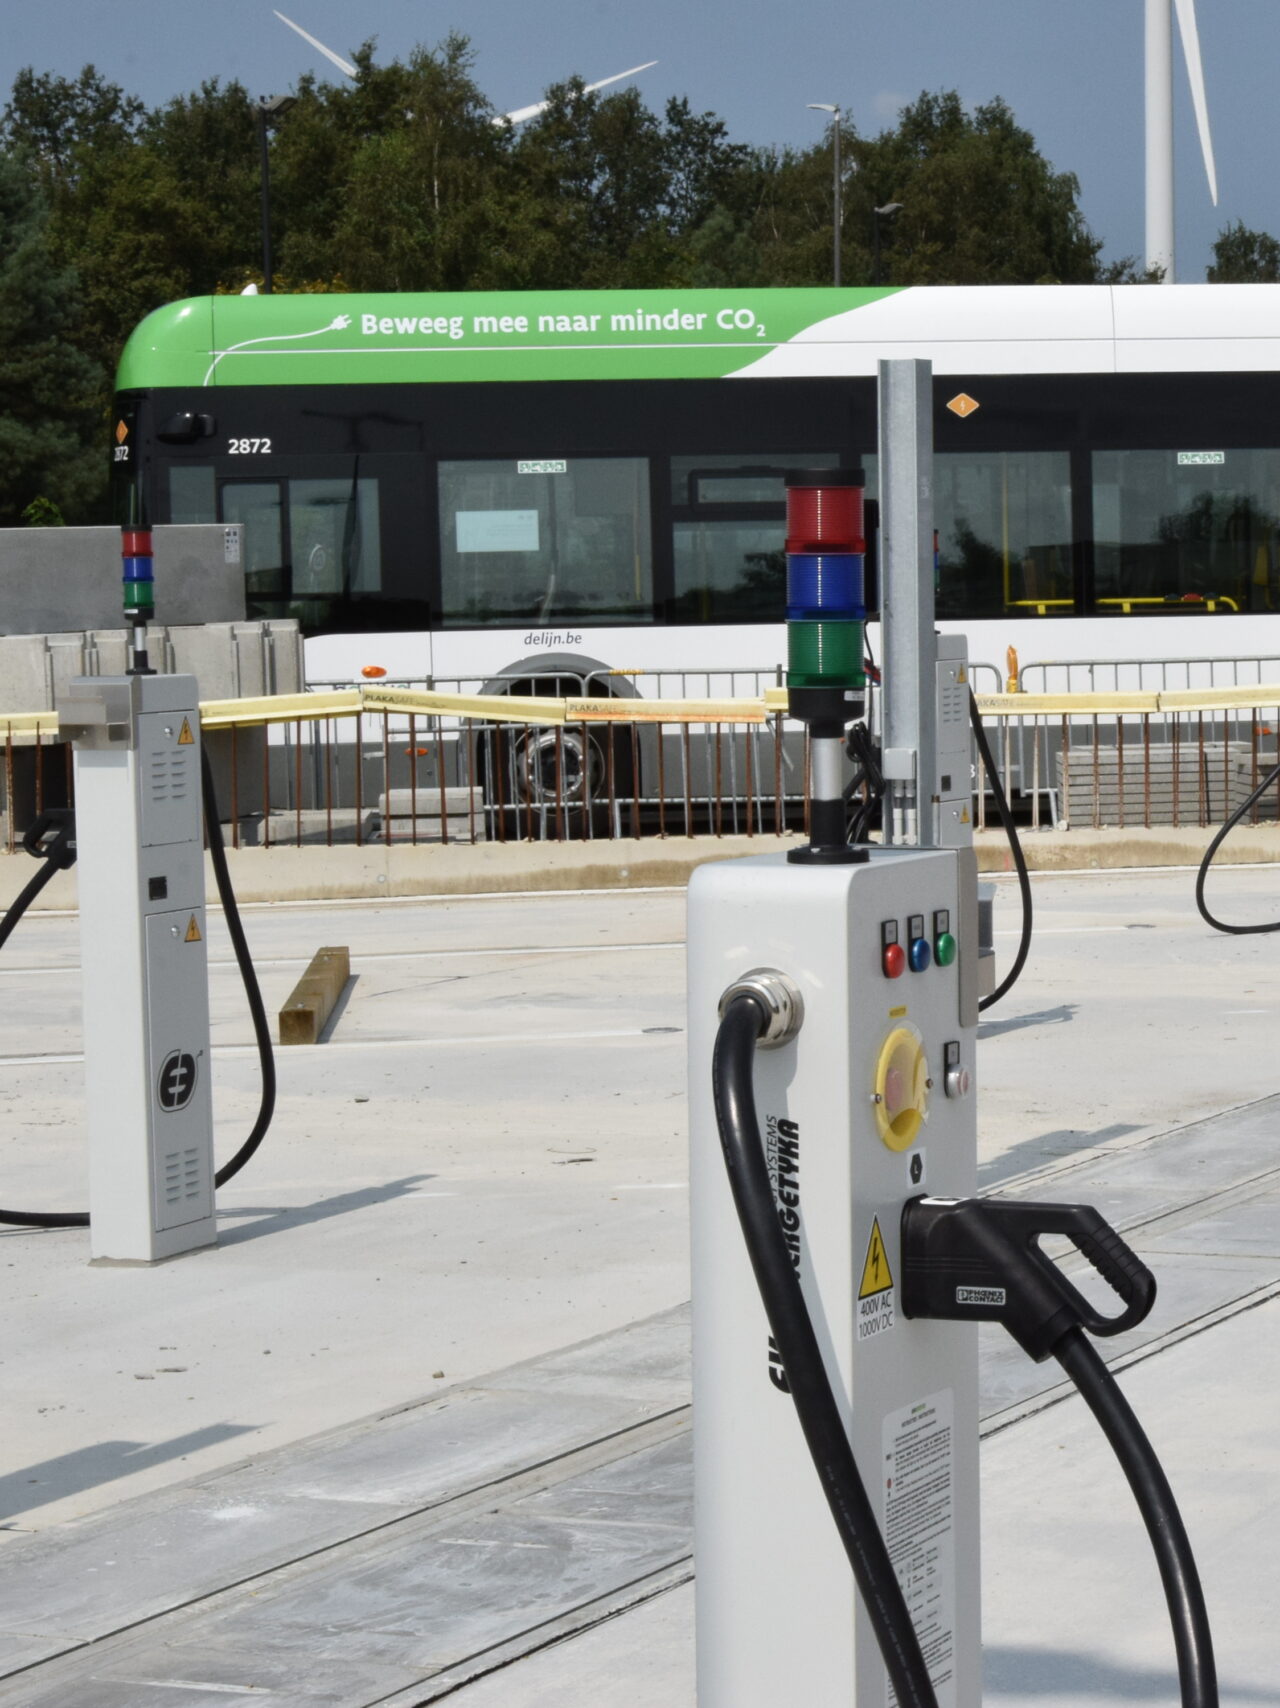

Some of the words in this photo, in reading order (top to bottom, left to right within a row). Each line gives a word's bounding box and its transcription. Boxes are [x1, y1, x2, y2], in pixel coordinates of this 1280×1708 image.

[361, 313, 463, 339] Beweeg
[473, 315, 528, 333] mee
[538, 313, 600, 333] naar
[610, 308, 707, 331] minder
[228, 438, 271, 454] 2872
[524, 632, 582, 647] delijn.be
[766, 1115, 777, 1182] SYSTEMS
[860, 1297, 880, 1316] 400V
[881, 1291, 891, 1309] AC
[859, 1316, 881, 1338] 1000V
[882, 1311, 893, 1329] DC
